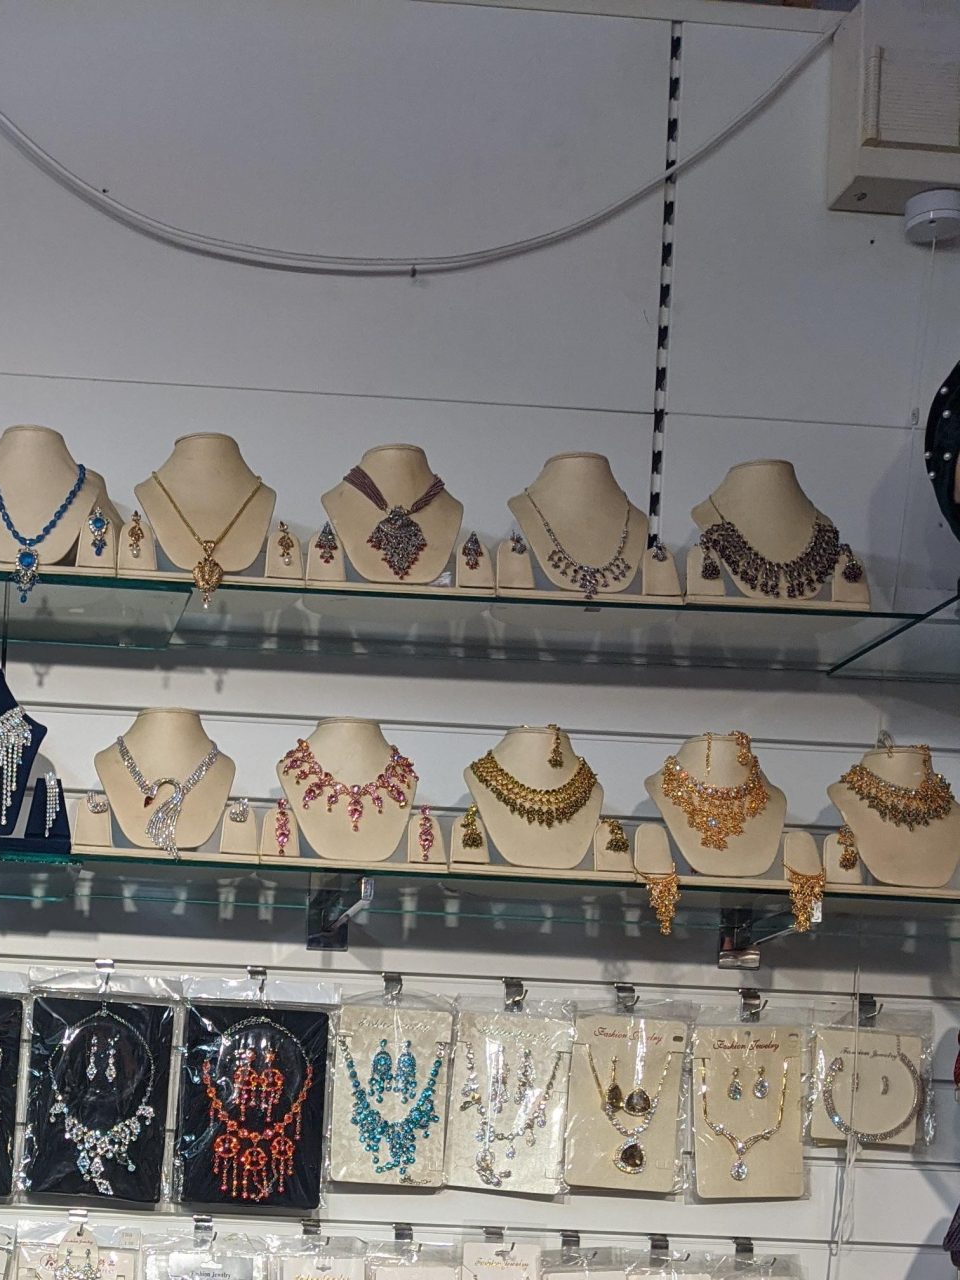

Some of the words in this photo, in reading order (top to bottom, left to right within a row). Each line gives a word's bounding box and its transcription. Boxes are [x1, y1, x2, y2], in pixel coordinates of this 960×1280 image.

[594, 1027, 627, 1039] Fashion
[713, 1040, 746, 1050] Fashion
[747, 1039, 780, 1052] Jewelry
